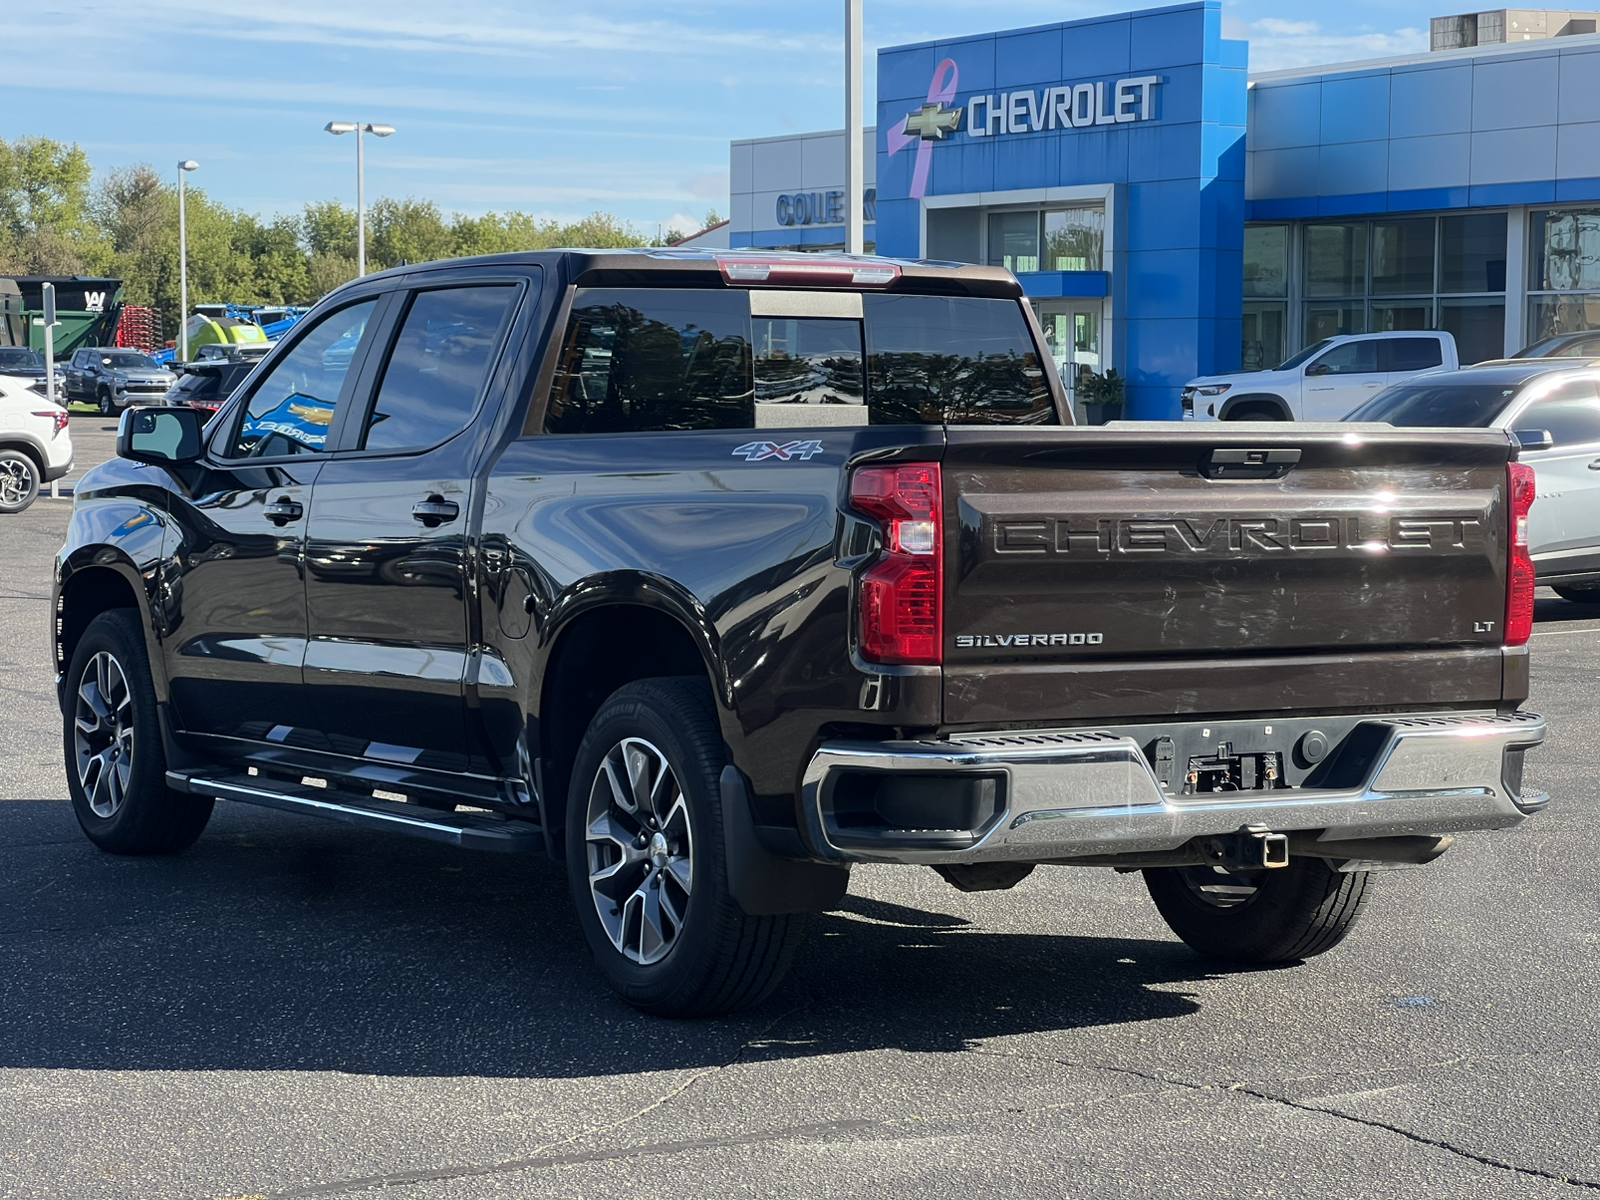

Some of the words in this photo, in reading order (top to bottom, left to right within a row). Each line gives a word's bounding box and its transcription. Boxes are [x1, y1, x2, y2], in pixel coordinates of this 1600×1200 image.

[967, 75, 1162, 137] CHEVROLET
[776, 191, 844, 226] COLE
[994, 517, 1480, 553] CHEVROLET
[956, 633, 1103, 647] SILVERADO
[1473, 621, 1496, 633] LT
